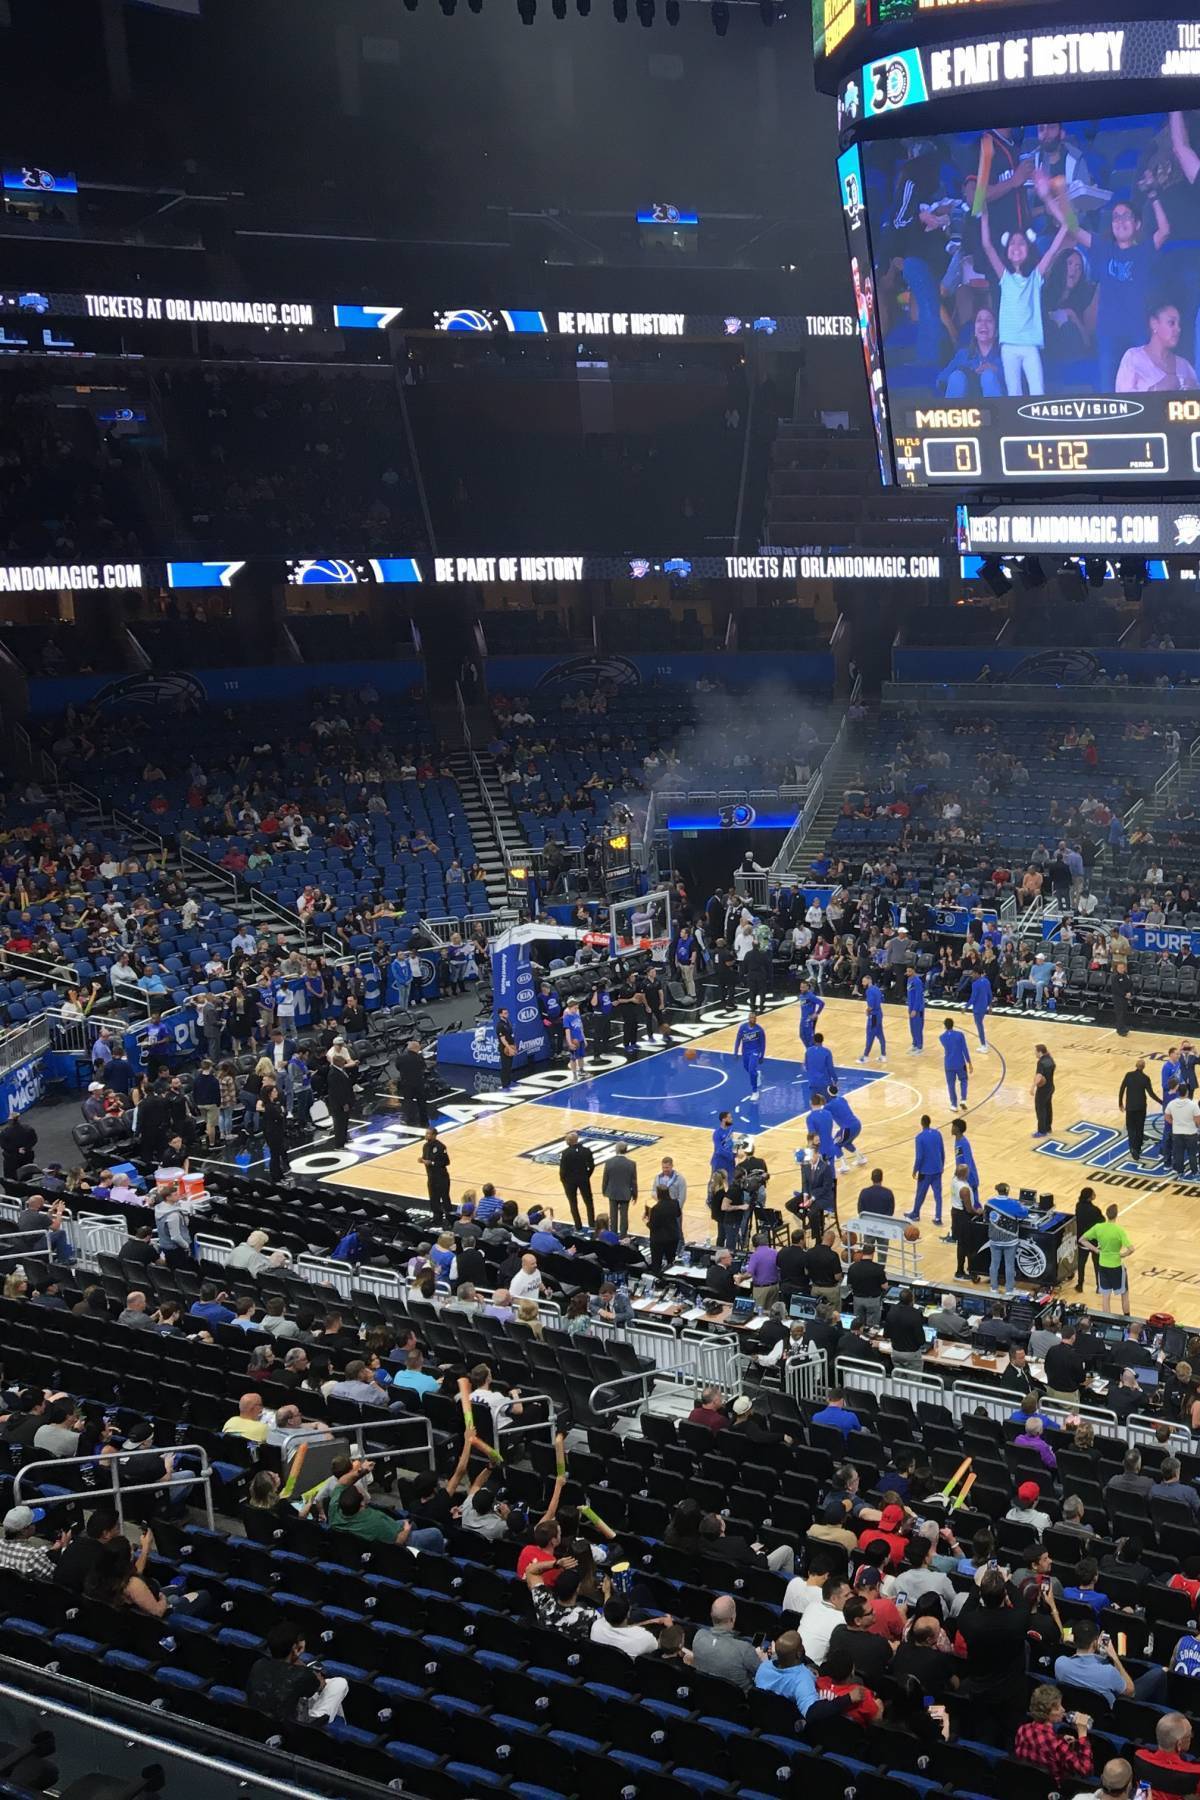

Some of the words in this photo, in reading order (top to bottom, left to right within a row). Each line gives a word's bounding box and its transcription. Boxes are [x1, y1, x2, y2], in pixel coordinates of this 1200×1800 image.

[931, 50, 952, 91] BE
[953, 42, 1000, 87] PART
[1003, 38, 1028, 80] OF
[1032, 31, 1124, 77] HISTORY
[85, 295, 143, 318] TICKETS
[147, 298, 161, 319] AT
[166, 299, 312, 325] ORLANDOMAGIC.COM
[558, 312, 575, 333] BE
[577, 313, 610, 334] PART
[613, 313, 628, 334] OF
[631, 314, 684, 335] HISTORY
[806, 316, 852, 335] TICKETS
[916, 409, 981, 428] MAGIC
[955, 444, 971, 470] 0
[1027, 441, 1088, 470] 4:02
[1145, 442, 1151, 459] 1
[970, 517, 998, 542] TICKETS
[999, 516, 1010, 542] AT
[1011, 516, 1159, 543] ORLANDOMAGIC.COM
[435, 558, 454, 581] BE
[457, 558, 496, 581] PART
[499, 558, 518, 581] OF
[520, 557, 583, 580] HISTORY
[726, 557, 778, 578] TICKETS
[783, 557, 797, 577] AT
[801, 557, 940, 578] ORLANDOMAGIC.COM
[1144, 932, 1191, 950] PURE
[518, 973, 532, 984] KIA
[518, 990, 533, 1001] KIA
[519, 1007, 537, 1021] KIA
[518, 1036, 545, 1051] Amway
